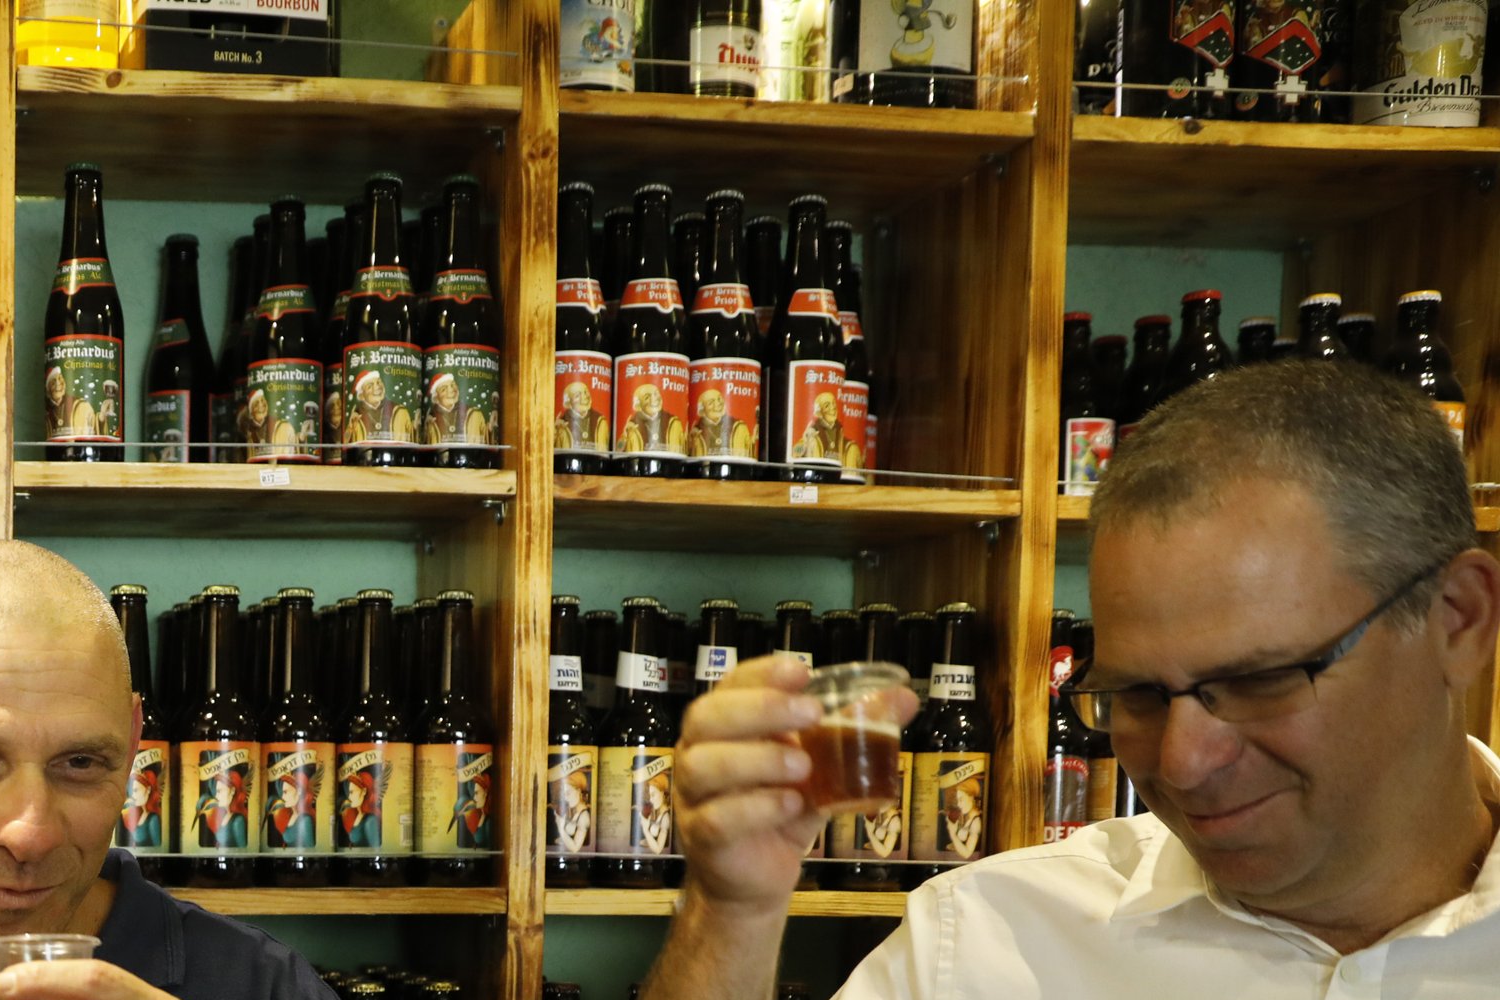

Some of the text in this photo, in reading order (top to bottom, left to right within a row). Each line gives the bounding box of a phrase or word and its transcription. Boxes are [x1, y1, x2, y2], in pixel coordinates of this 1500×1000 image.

[214, 51, 239, 62] BATCH
[255, 51, 262, 64] 3
[54, 346, 115, 360] Bernardus
[256, 369, 315, 382] Bernardus
[726, 383, 752, 396] Prior
